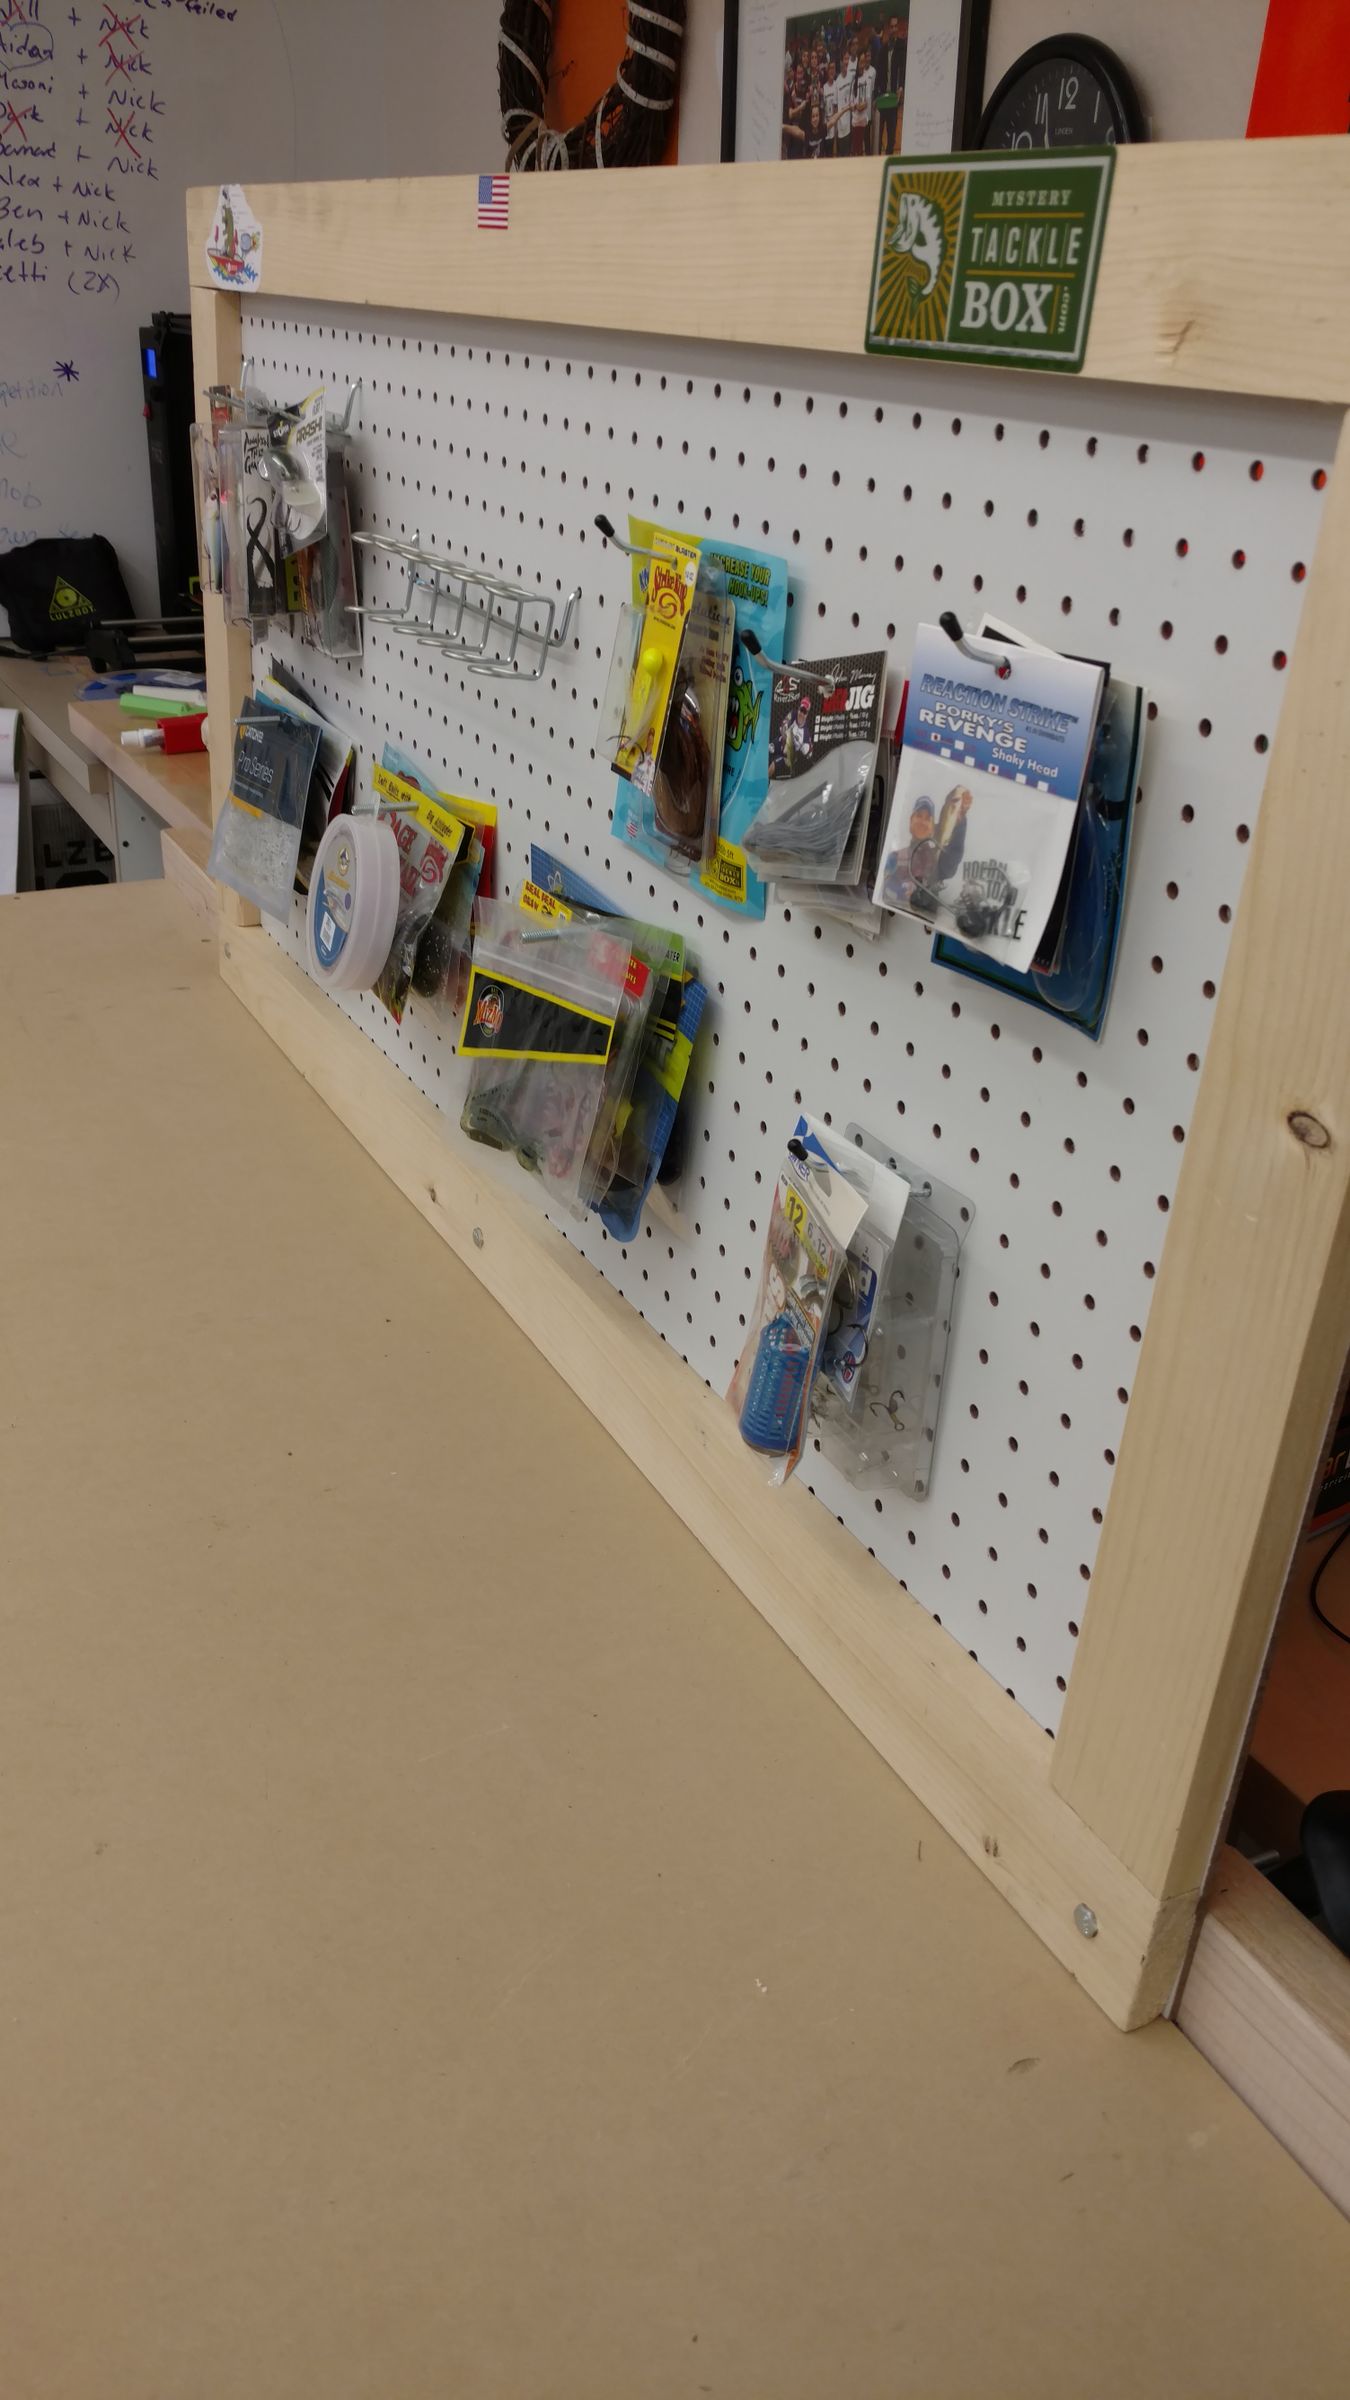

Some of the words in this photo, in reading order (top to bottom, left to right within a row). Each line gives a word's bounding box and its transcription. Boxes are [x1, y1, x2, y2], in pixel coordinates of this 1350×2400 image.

[108, 88, 166, 115] Nick
[1058, 76, 1079, 110] 12
[1093, 90, 1101, 124] 1
[107, 156, 159, 181] Nick
[73, 183, 116, 201] Nick
[991, 189, 1072, 207] MYSTERY
[78, 210, 132, 234] Nick
[970, 225, 1084, 266] TACKLE
[959, 280, 1053, 335] BOX
[750, 563, 772, 587] YOUR
[845, 685, 876, 711] JIG
[919, 673, 1009, 715] REACTION
[918, 707, 1028, 754] REVENGE
[935, 701, 1014, 734] PORKY'S
[250, 756, 274, 784] Series
[991, 747, 1026, 770] Shaky
[1027, 758, 1060, 779] Head
[788, 1196, 804, 1227] 12
